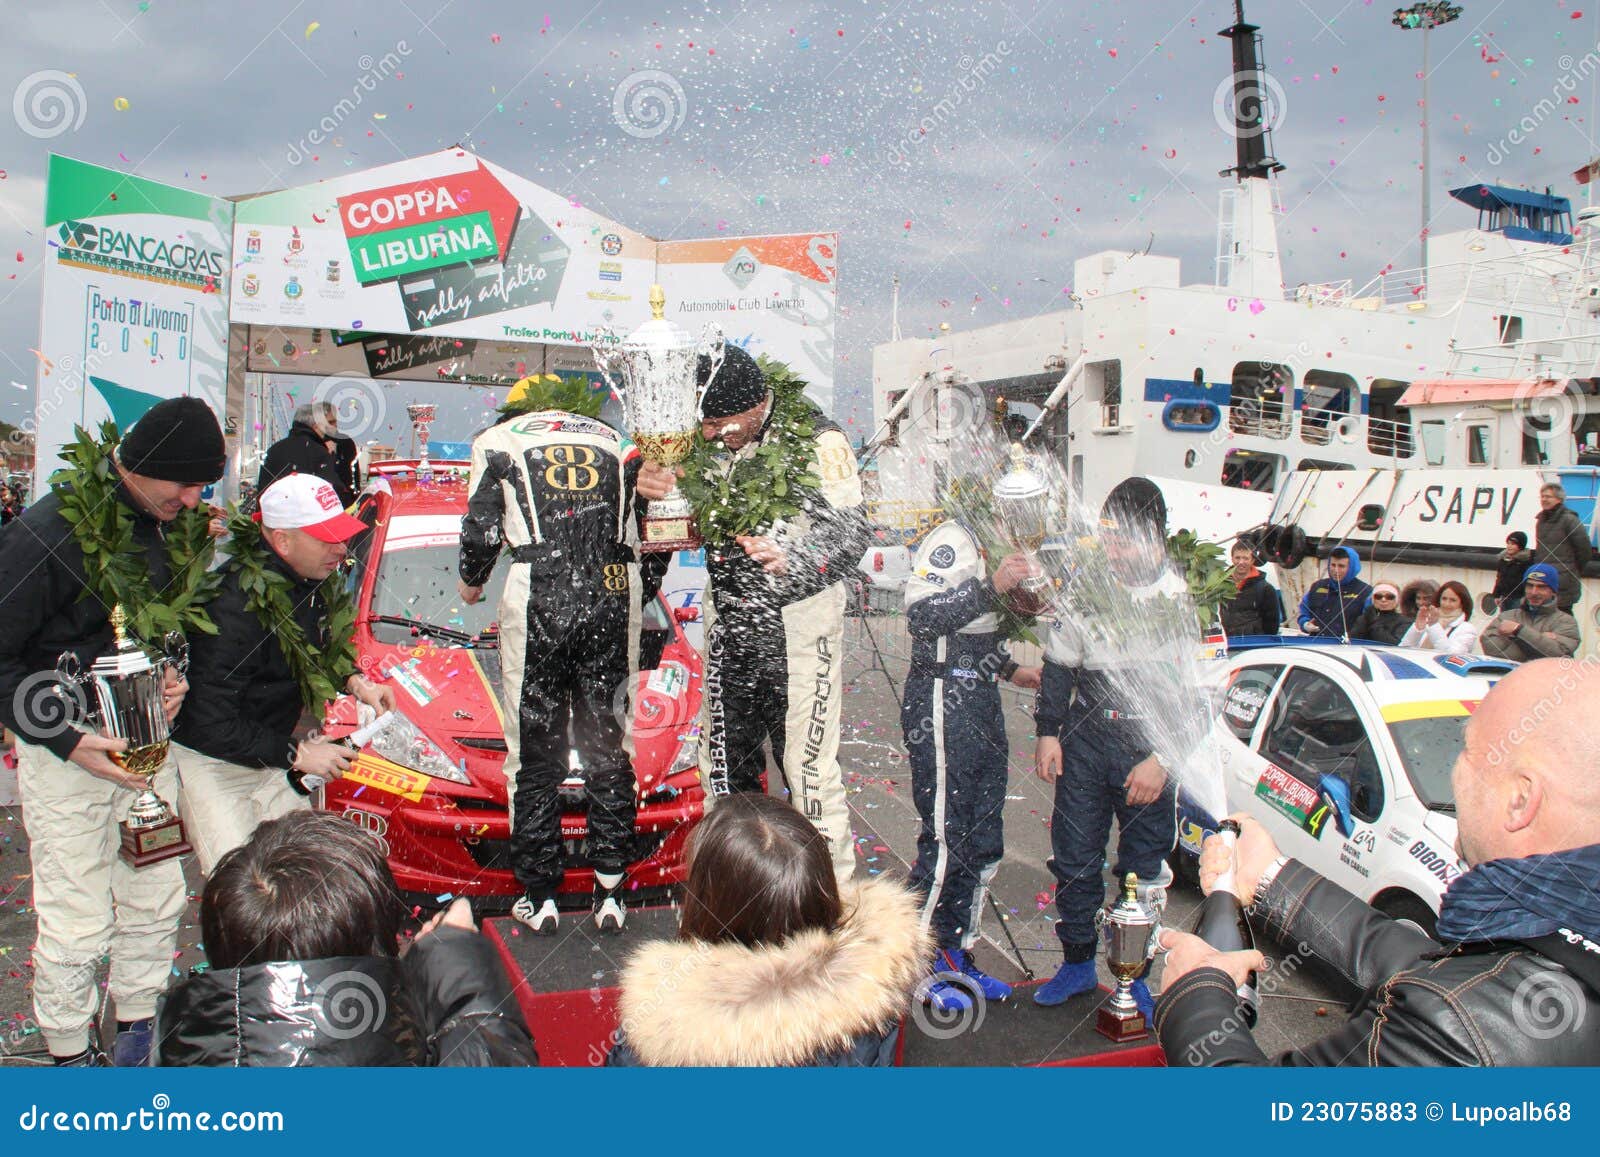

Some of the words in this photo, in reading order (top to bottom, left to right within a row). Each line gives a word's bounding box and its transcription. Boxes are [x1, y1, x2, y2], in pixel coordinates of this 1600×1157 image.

[348, 186, 458, 229] COPPA
[100, 227, 223, 277] BANCACRAS
[359, 224, 493, 272] LIBURNA
[417, 288, 471, 321] rally
[478, 262, 547, 303] asfalto
[738, 298, 760, 310] Club
[92, 293, 126, 323] Porto
[144, 303, 189, 333] Livorno
[503, 326, 540, 339] Trofeo
[543, 329, 574, 341] Porto
[578, 331, 620, 344] Livrno
[1419, 486, 1522, 525] SAPV
[349, 760, 418, 793] IRELLI
[1263, 765, 1287, 789] COPPA
[1283, 778, 1316, 808] LIBURNA
[1309, 805, 1328, 835] 4
